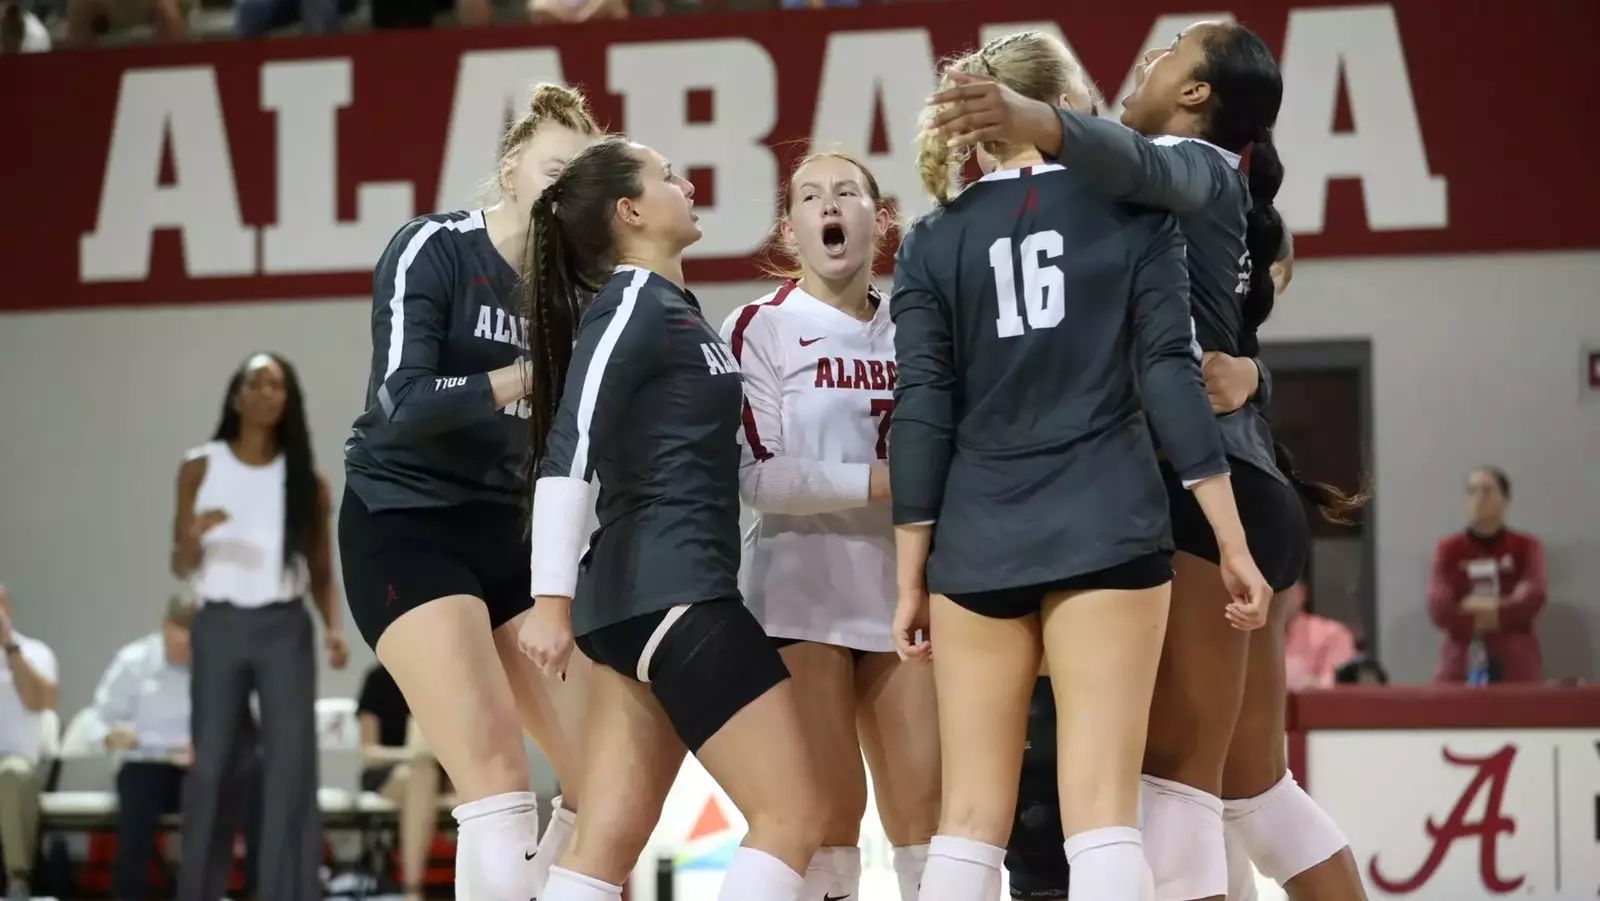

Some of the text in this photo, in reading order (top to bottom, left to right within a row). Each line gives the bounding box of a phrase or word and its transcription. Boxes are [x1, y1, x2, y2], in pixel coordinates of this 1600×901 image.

[989, 230, 1065, 338] 16
[435, 376, 467, 391] ROLL
[870, 398, 894, 459] 7
[1369, 742, 1526, 896] A
